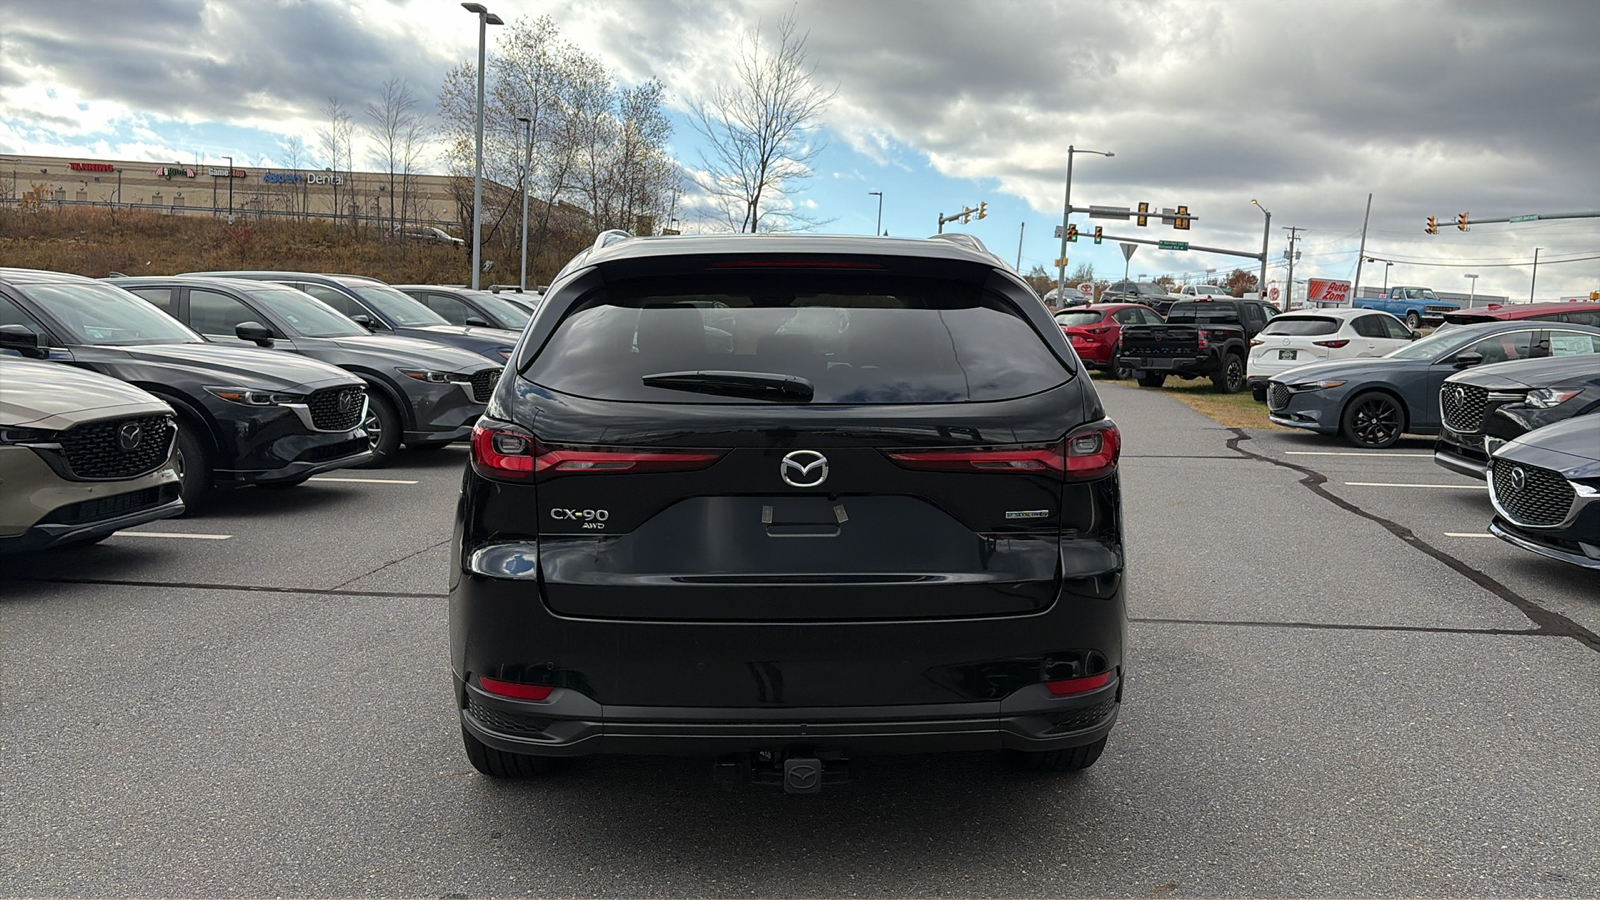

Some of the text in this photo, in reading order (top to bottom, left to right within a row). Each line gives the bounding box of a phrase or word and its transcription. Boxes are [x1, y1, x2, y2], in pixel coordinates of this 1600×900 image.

[69, 162, 114, 172] TANNING
[209, 168, 246, 178] Gametop
[263, 172, 345, 186] Aspen Dental
[1327, 281, 1349, 292] Auto
[1322, 291, 1346, 301] Zone
[550, 508, 609, 521] CX-90
